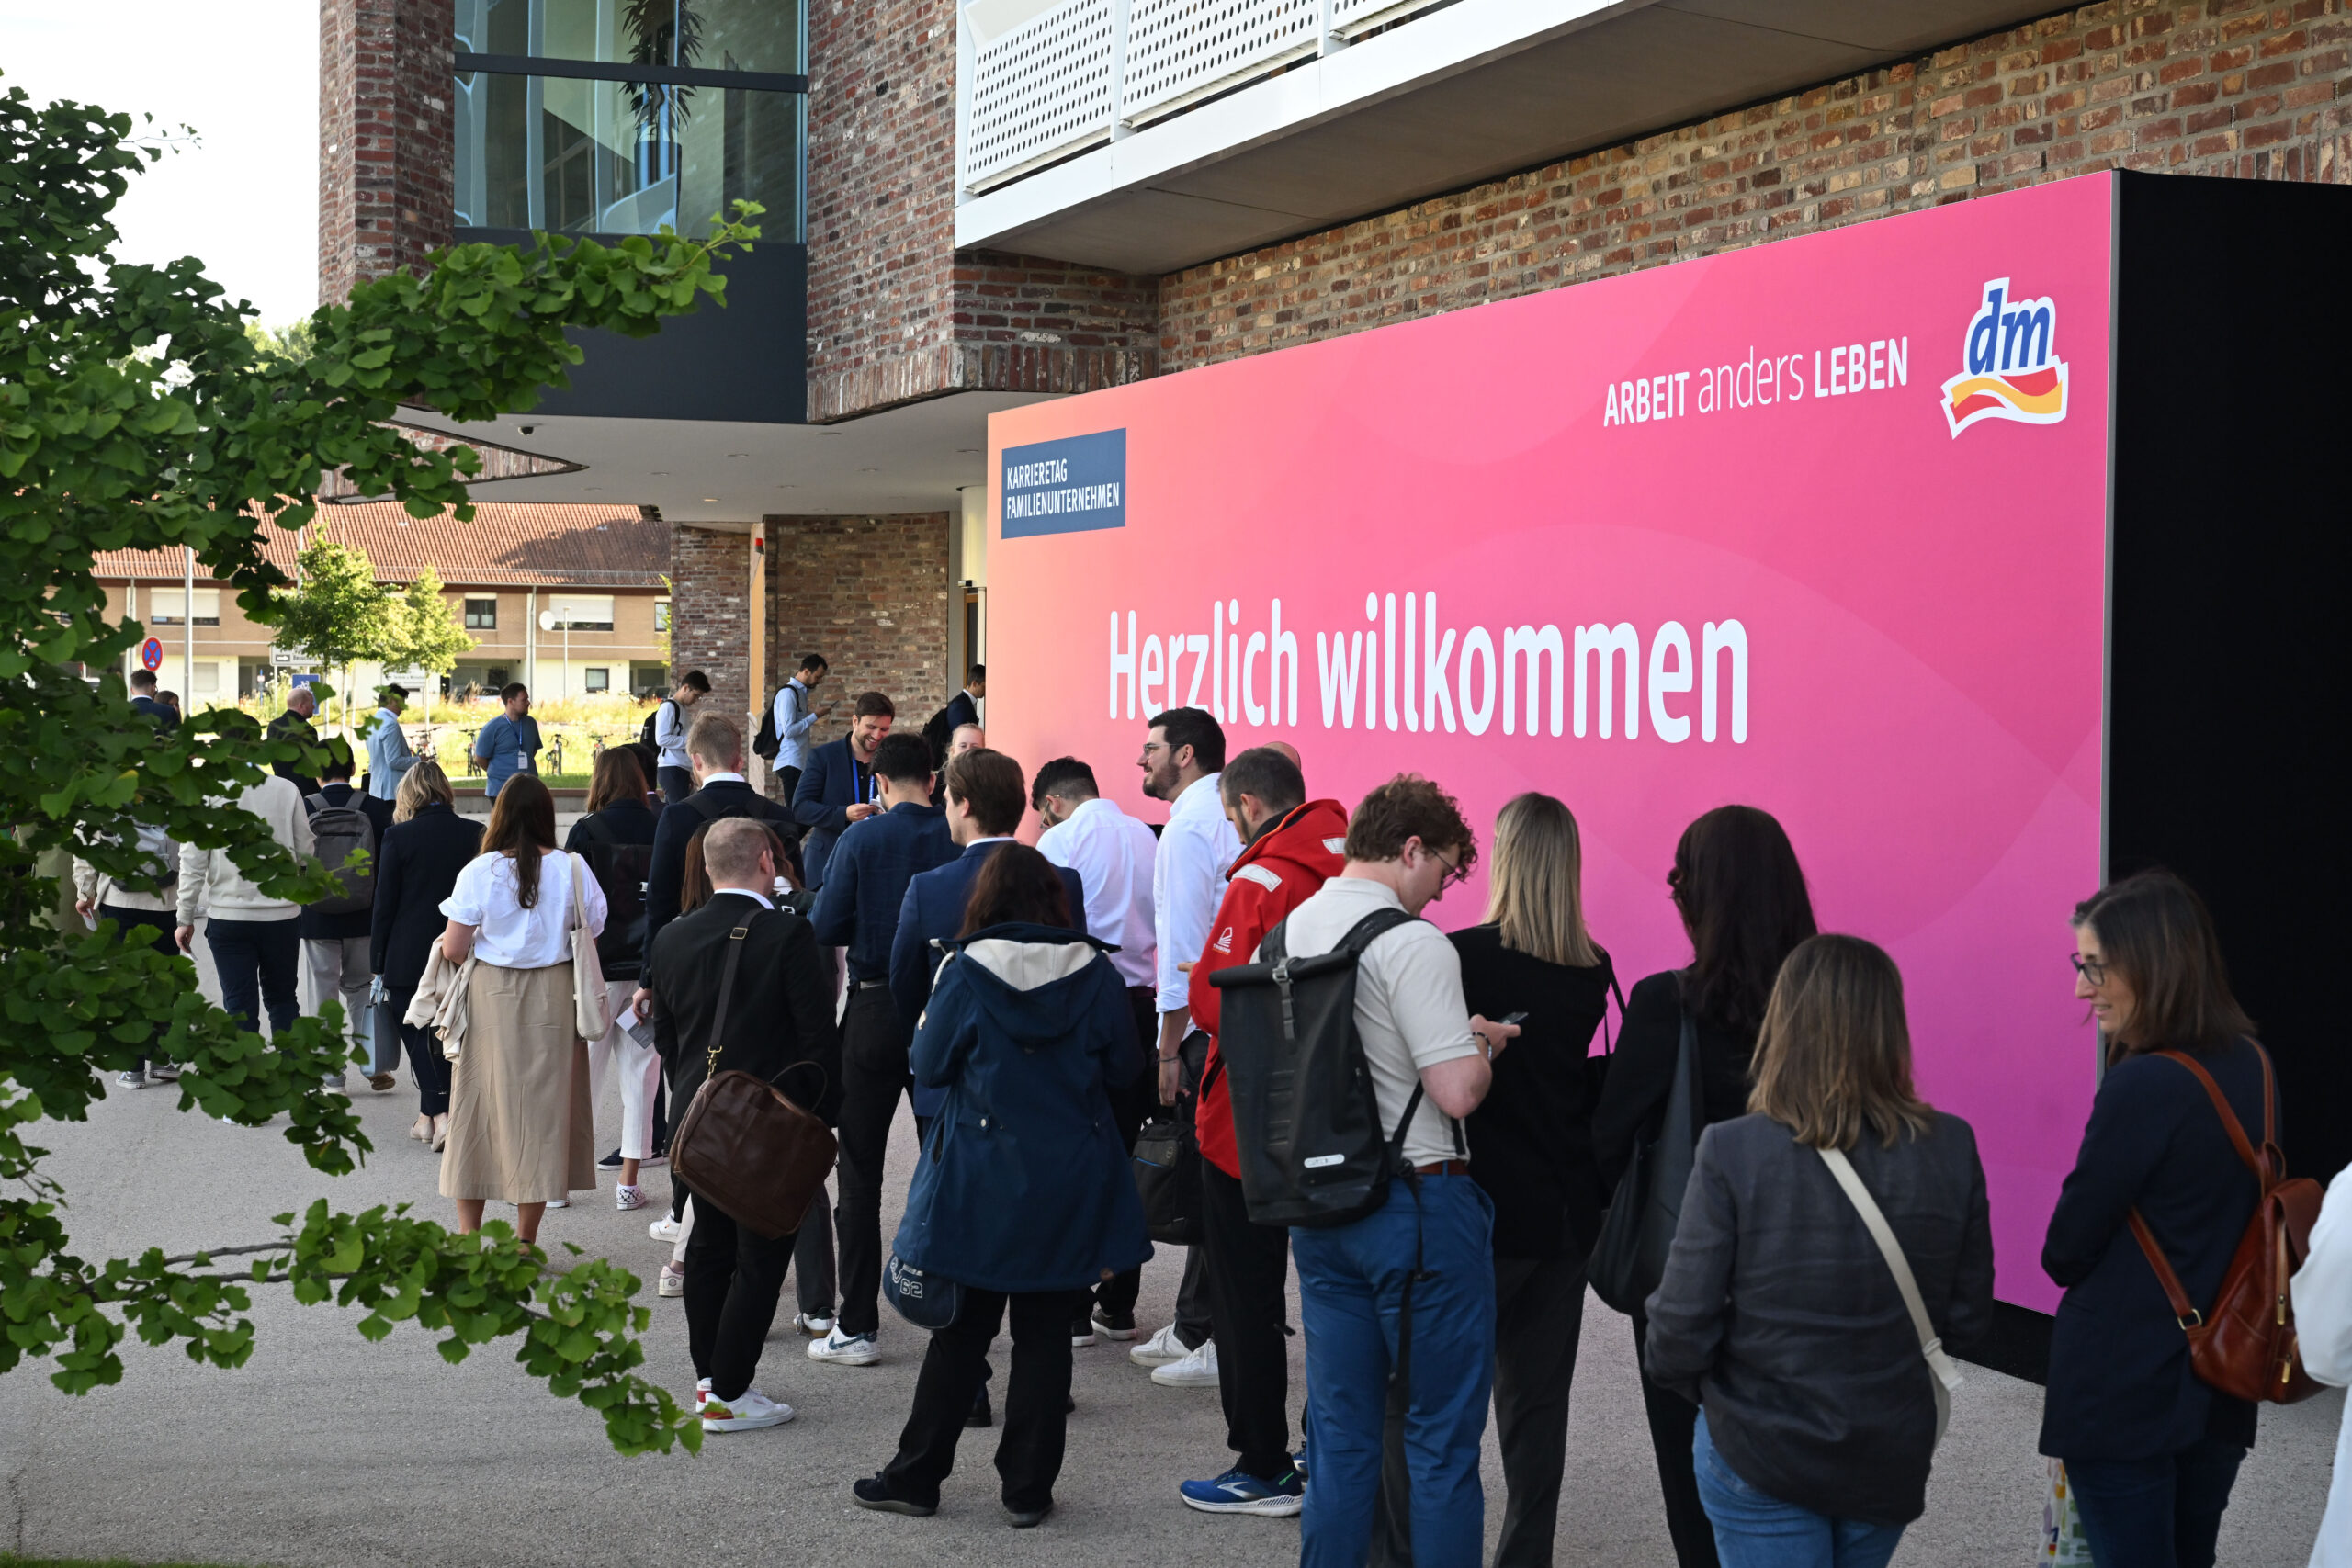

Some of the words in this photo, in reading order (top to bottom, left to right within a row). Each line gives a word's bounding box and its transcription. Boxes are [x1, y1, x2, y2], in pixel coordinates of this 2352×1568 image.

[1969, 288, 2051, 376] dm
[1603, 371, 1690, 427] ARBEIT
[1698, 345, 1804, 413] anders
[1815, 336, 1908, 398] LEBEN
[1007, 458, 1068, 490] KARRIERETAG
[1007, 482, 1120, 520] FAMILIENUNTERNEHMEN
[1109, 598, 1298, 728] Herzlich
[1317, 591, 1748, 744] willkommen
[900, 1278, 923, 1298] 62
